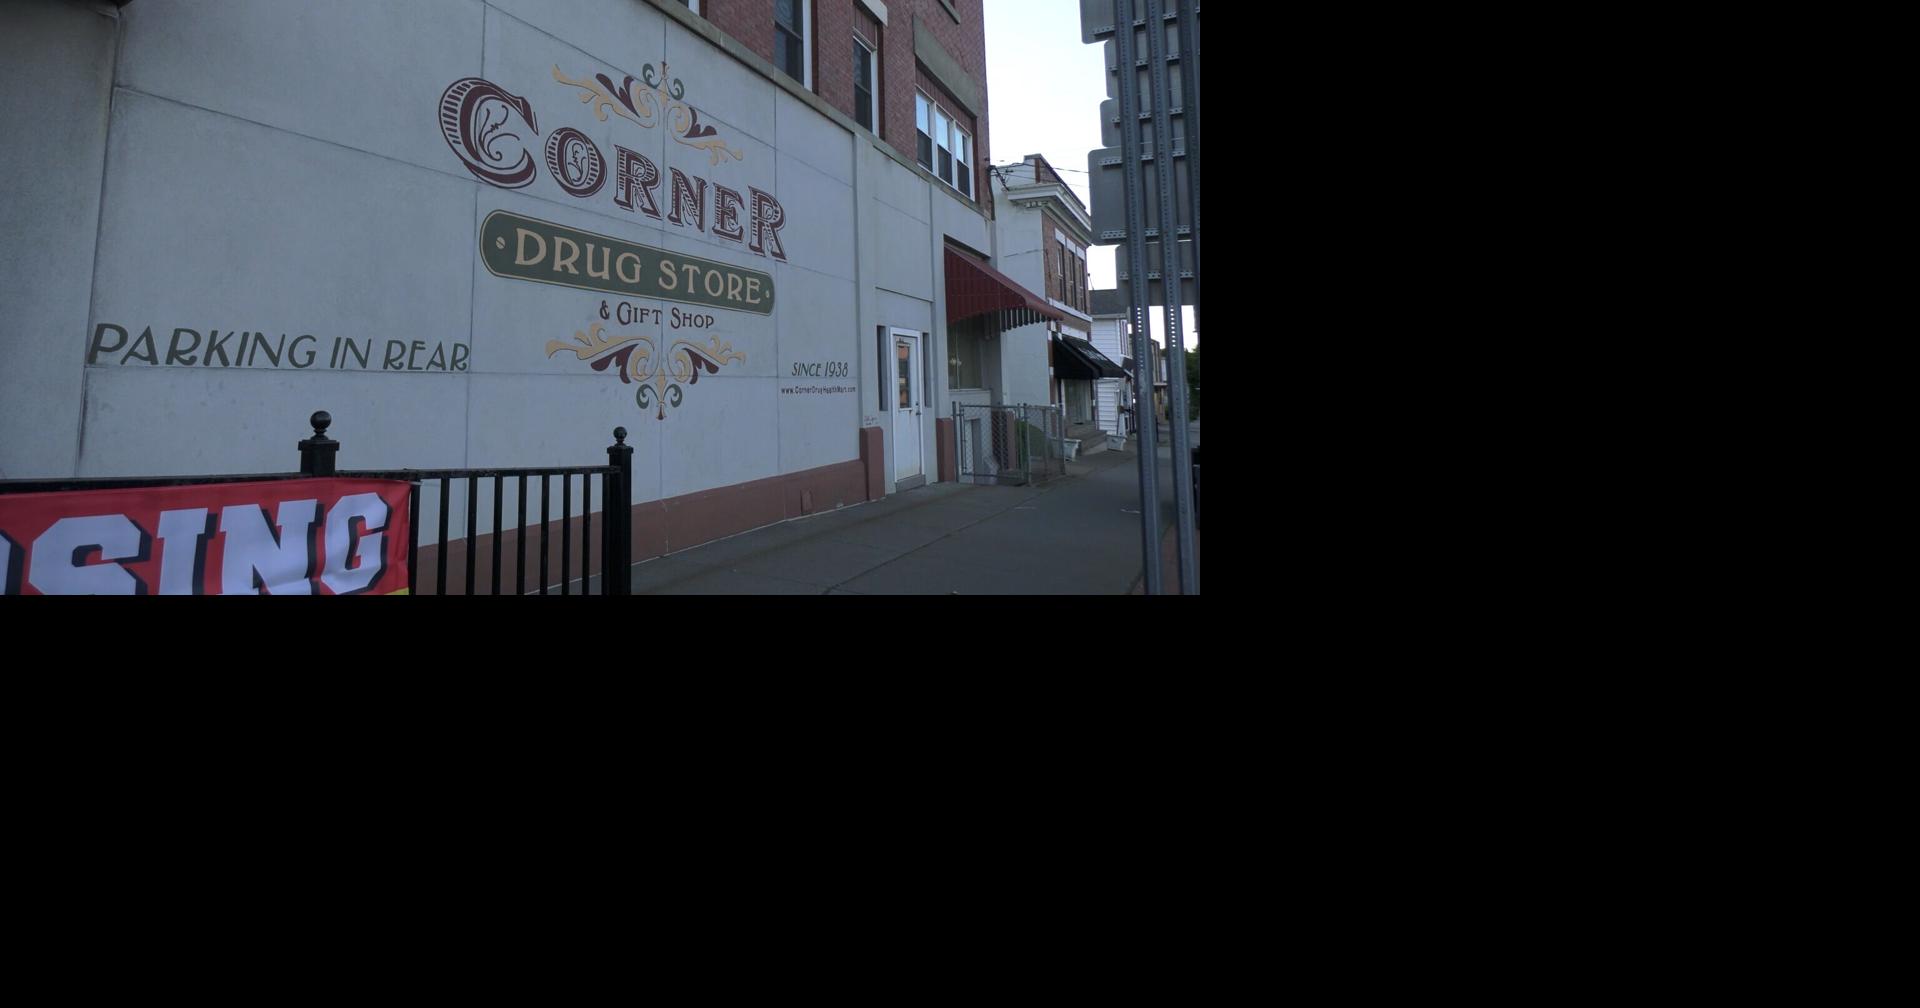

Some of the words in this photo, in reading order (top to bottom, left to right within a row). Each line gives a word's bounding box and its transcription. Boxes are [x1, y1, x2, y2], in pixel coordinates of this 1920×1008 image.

[438, 77, 787, 263] CORNER
[515, 227, 642, 284] DRUG
[658, 259, 761, 304] STORE
[600, 300, 610, 320] &
[617, 301, 662, 325] GIFT
[671, 307, 714, 329] SHOP
[87, 323, 316, 369] PARKING
[330, 336, 372, 370] IN
[383, 339, 469, 371] REAR
[791, 362, 822, 377] SINCE
[824, 361, 849, 378] 1938
[0, 492, 392, 595] SING
